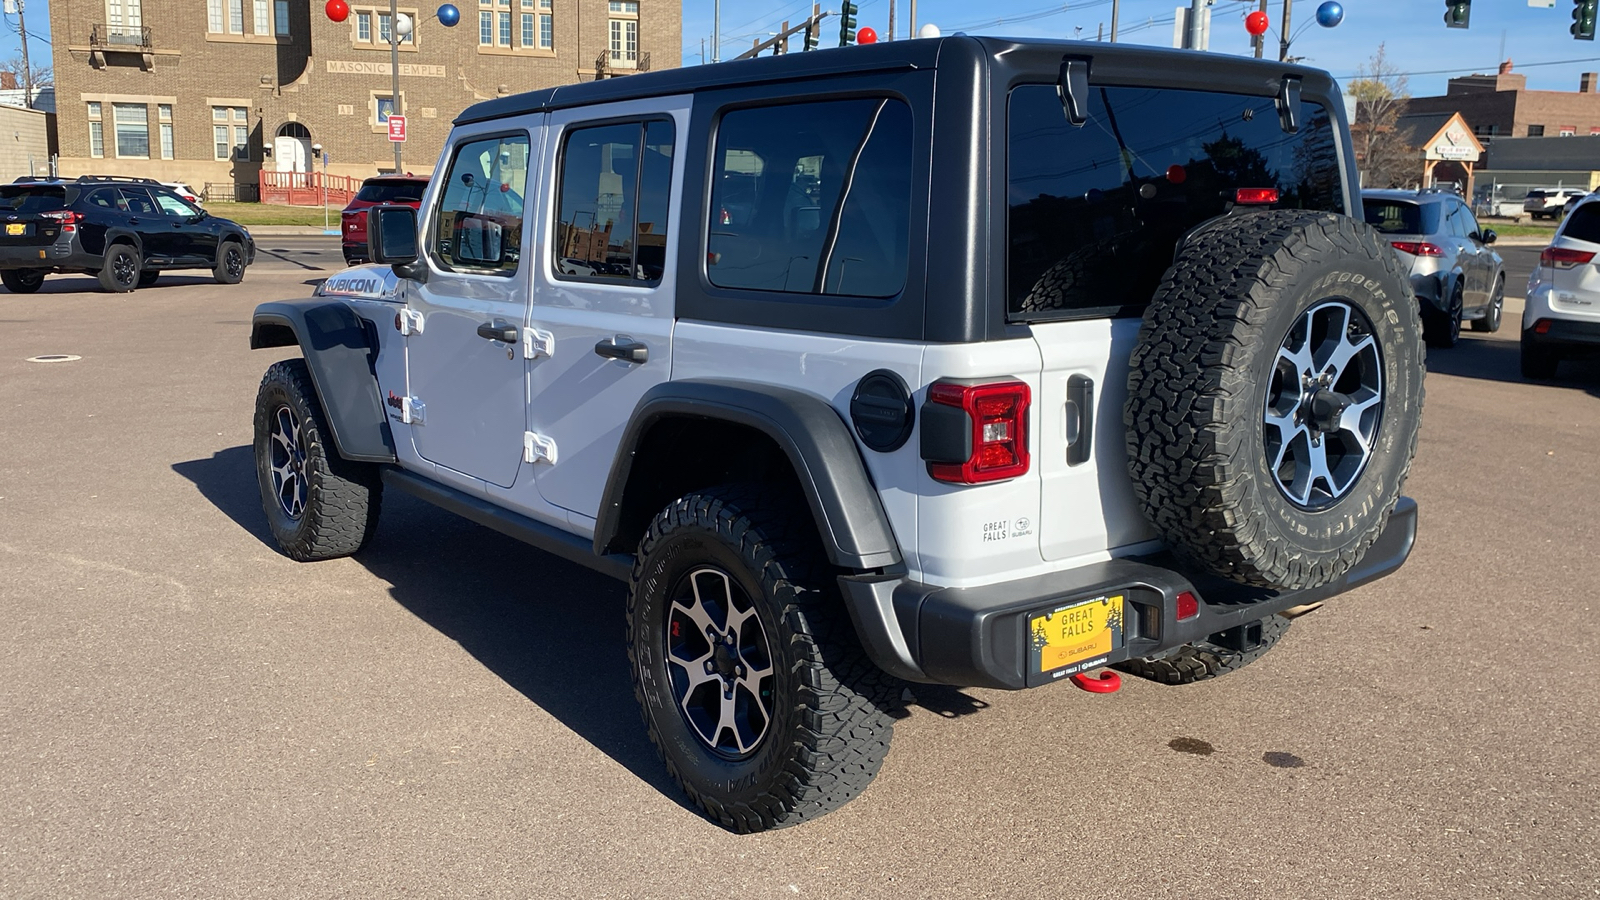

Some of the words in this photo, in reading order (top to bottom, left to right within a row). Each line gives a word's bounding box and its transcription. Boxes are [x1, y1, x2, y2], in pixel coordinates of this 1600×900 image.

[329, 61, 386, 73] MASONIC
[325, 279, 377, 293] RUBICON
[983, 520, 1006, 532] GREAT
[983, 530, 1006, 542] FALLS
[1012, 530, 1032, 538] SUBARU
[1061, 608, 1094, 626] GREAT
[1061, 621, 1094, 639] FALLS
[1068, 643, 1098, 656] SUBARU
